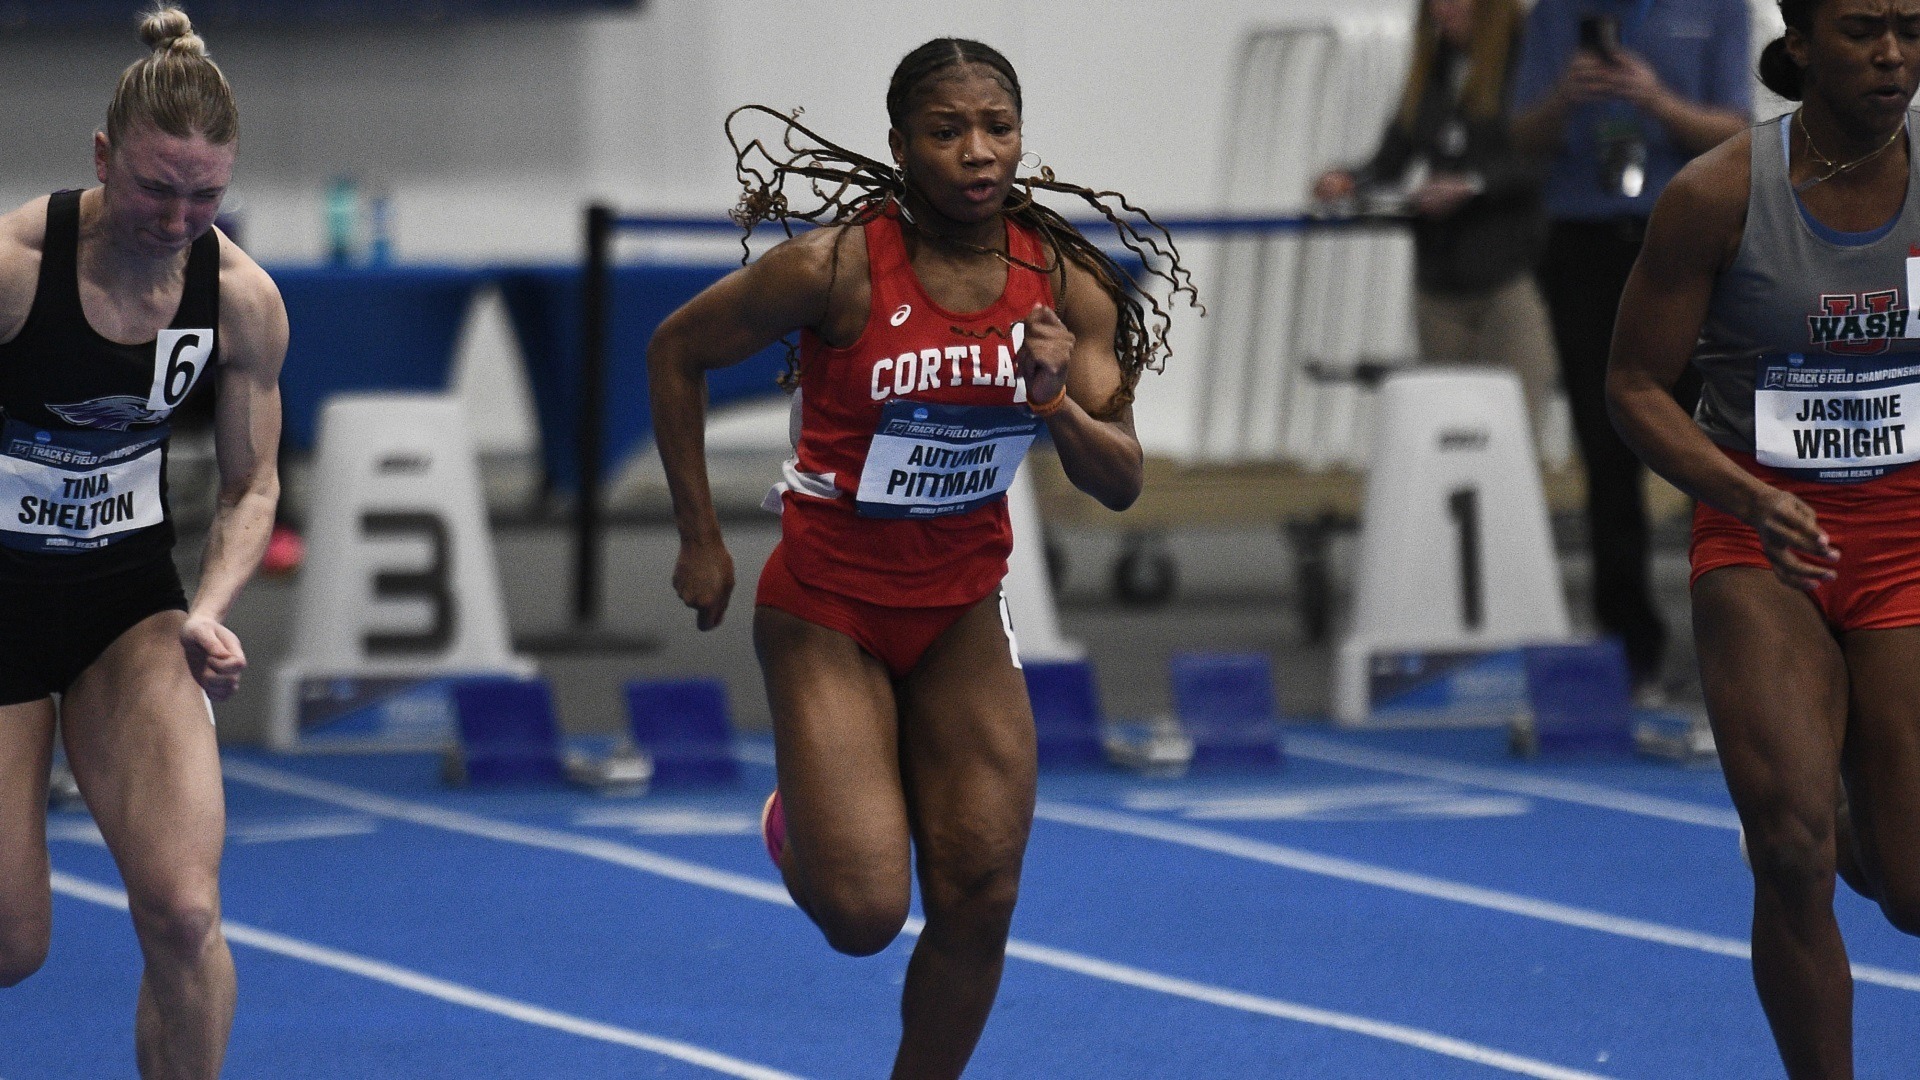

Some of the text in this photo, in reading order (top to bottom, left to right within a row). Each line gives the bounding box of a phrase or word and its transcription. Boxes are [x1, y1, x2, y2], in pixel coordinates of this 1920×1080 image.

[1807, 309, 1910, 343] WASH
[164, 333, 200, 406] 6
[870, 345, 1017, 401] CORTLA
[1787, 373, 1818, 383] TRACK
[1819, 374, 1826, 383] &
[1827, 374, 1853, 384] FIELD
[1796, 394, 1901, 422] JASMINE
[907, 425, 936, 435] TRACK
[944, 429, 970, 438] FIELD
[1793, 424, 1906, 460] WRIGHT
[32, 446, 64, 461] TRACK
[71, 454, 98, 465] FIELD
[907, 444, 997, 469] AUTUMN
[63, 473, 109, 499] TINA
[886, 467, 999, 498] PITTMAN
[18, 491, 134, 530] SHELTON
[1446, 488, 1483, 629] 1
[359, 512, 458, 657] 3
